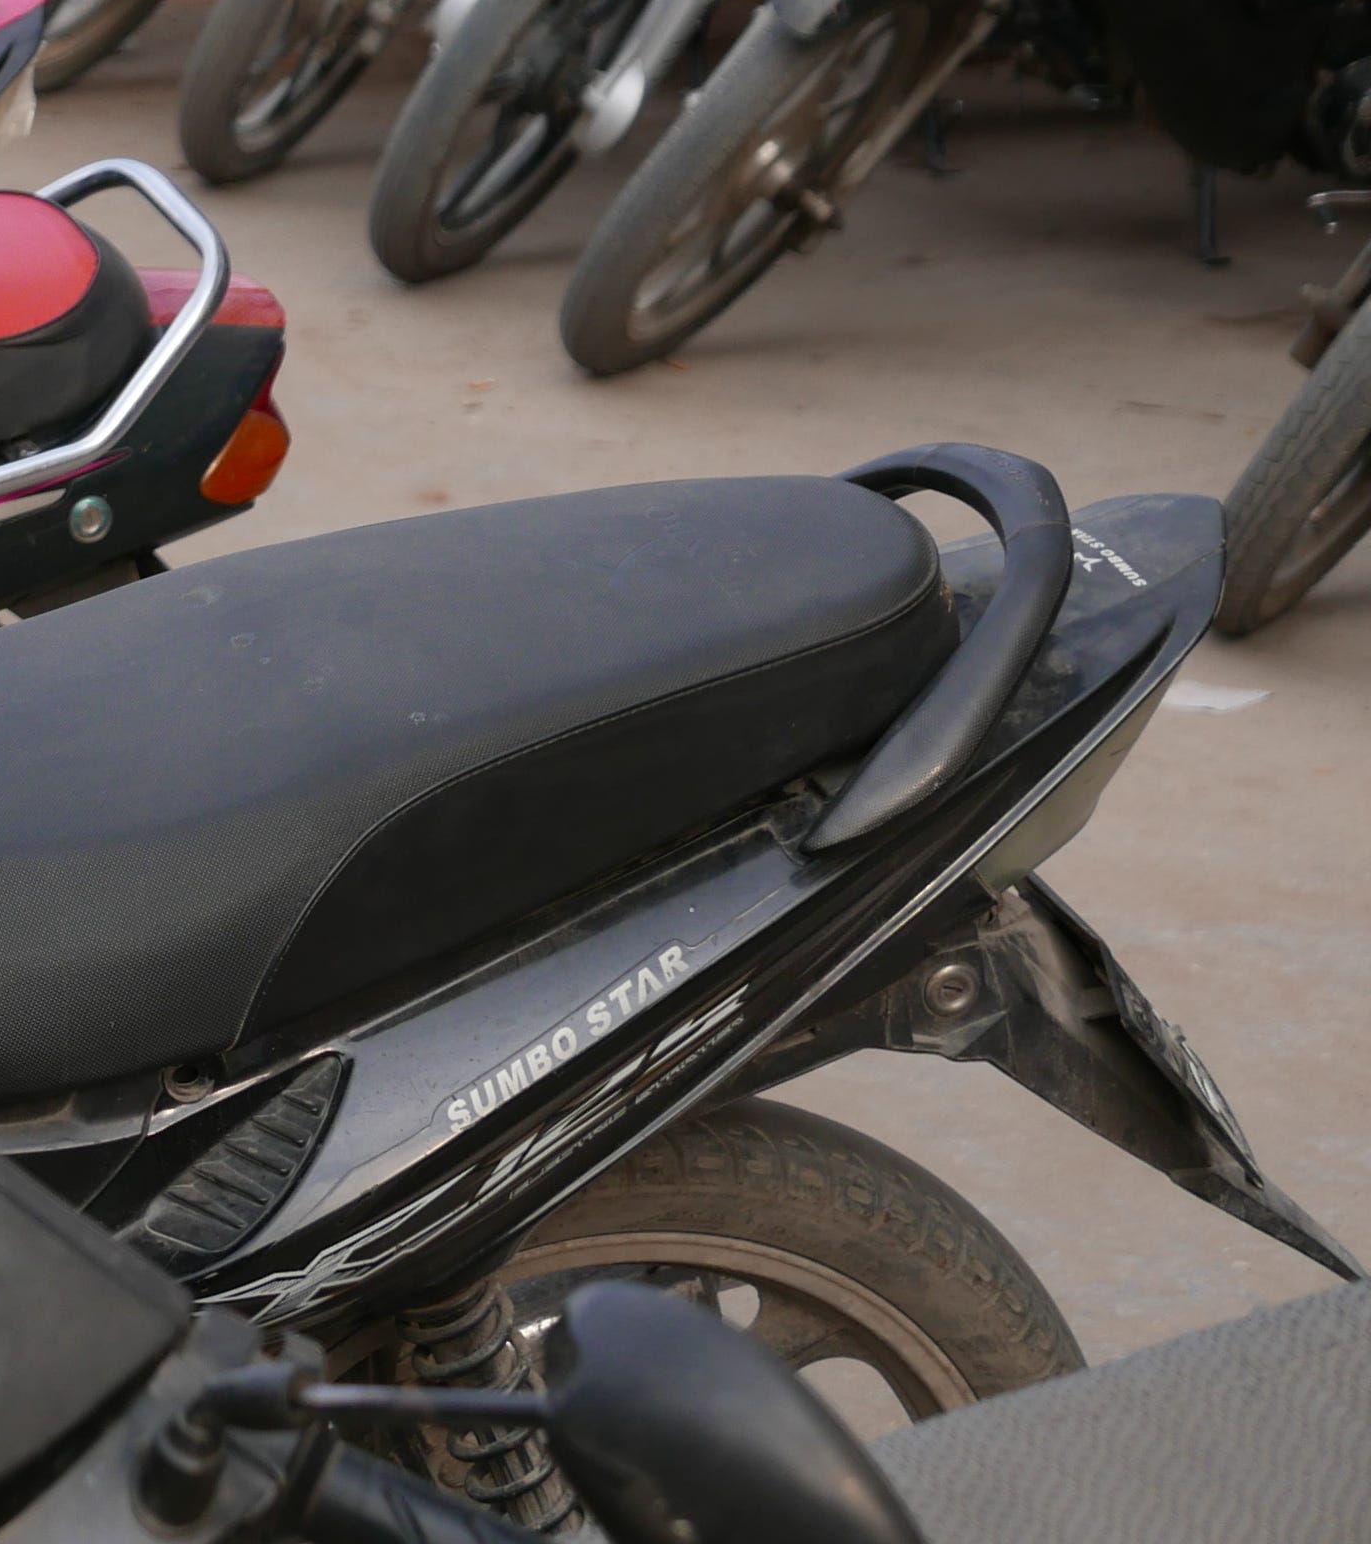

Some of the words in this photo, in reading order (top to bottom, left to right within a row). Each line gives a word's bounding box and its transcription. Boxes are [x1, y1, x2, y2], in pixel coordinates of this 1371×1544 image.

[1100, 548, 1148, 587] SUMBO
[447, 1025, 578, 1134] SUMBO
[586, 944, 690, 1037] STAR
